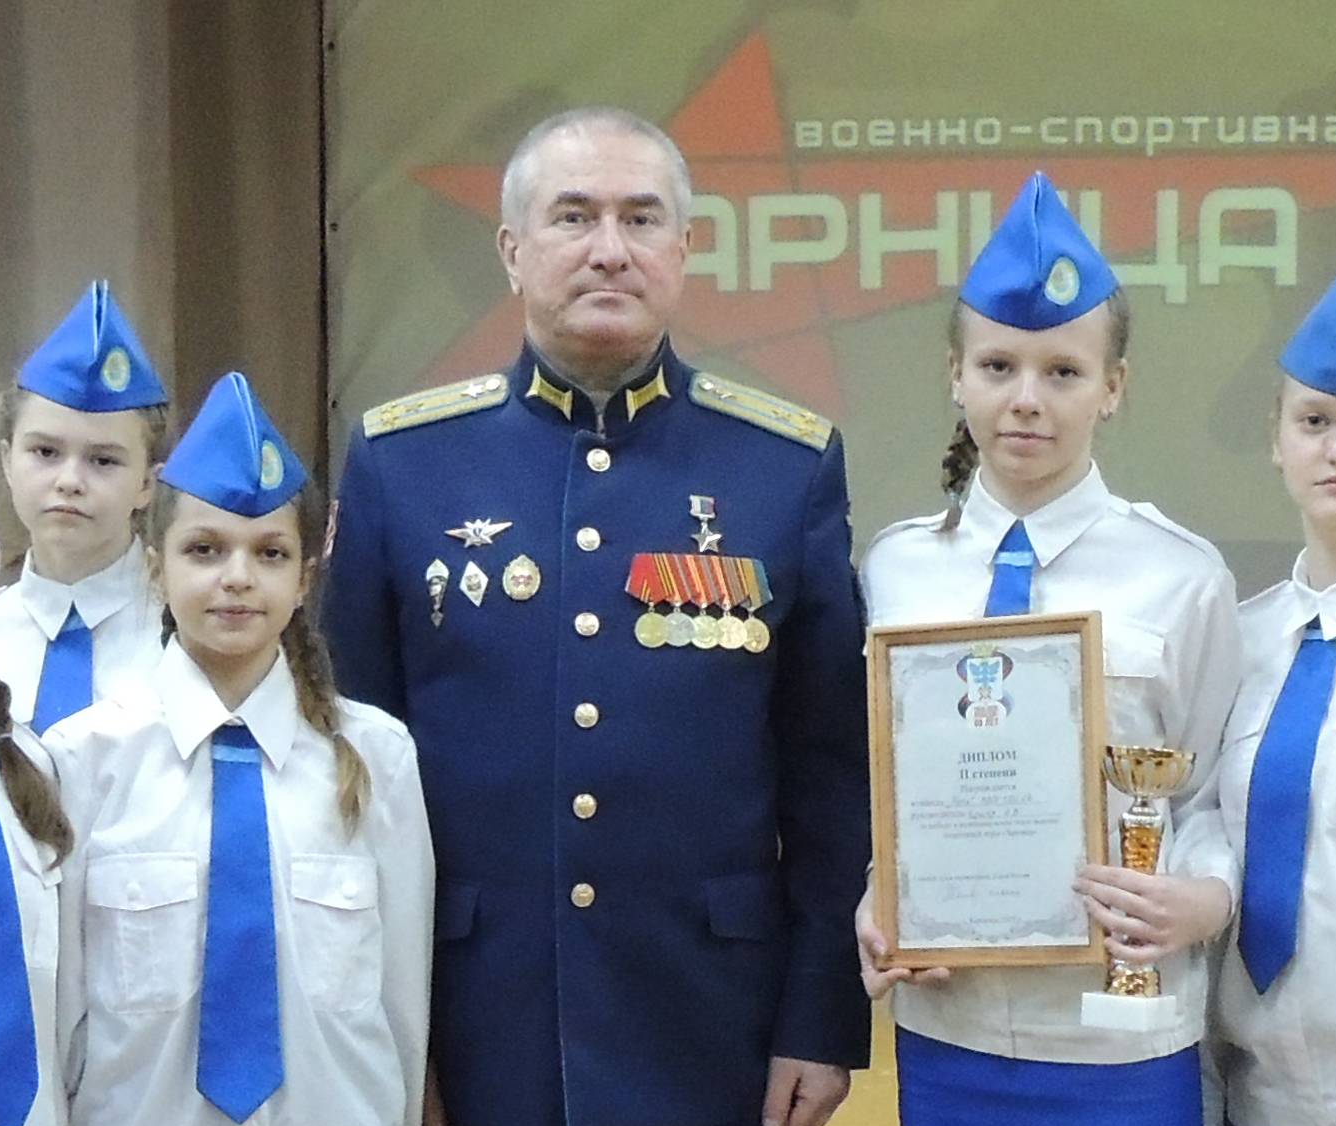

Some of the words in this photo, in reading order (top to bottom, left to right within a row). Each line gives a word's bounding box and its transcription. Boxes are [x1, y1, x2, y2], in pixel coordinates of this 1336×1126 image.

[683, 187, 1298, 304] АРНЦА
[958, 751, 1017, 765] ДИПЛОМ
[972, 768, 1017, 780] степени
